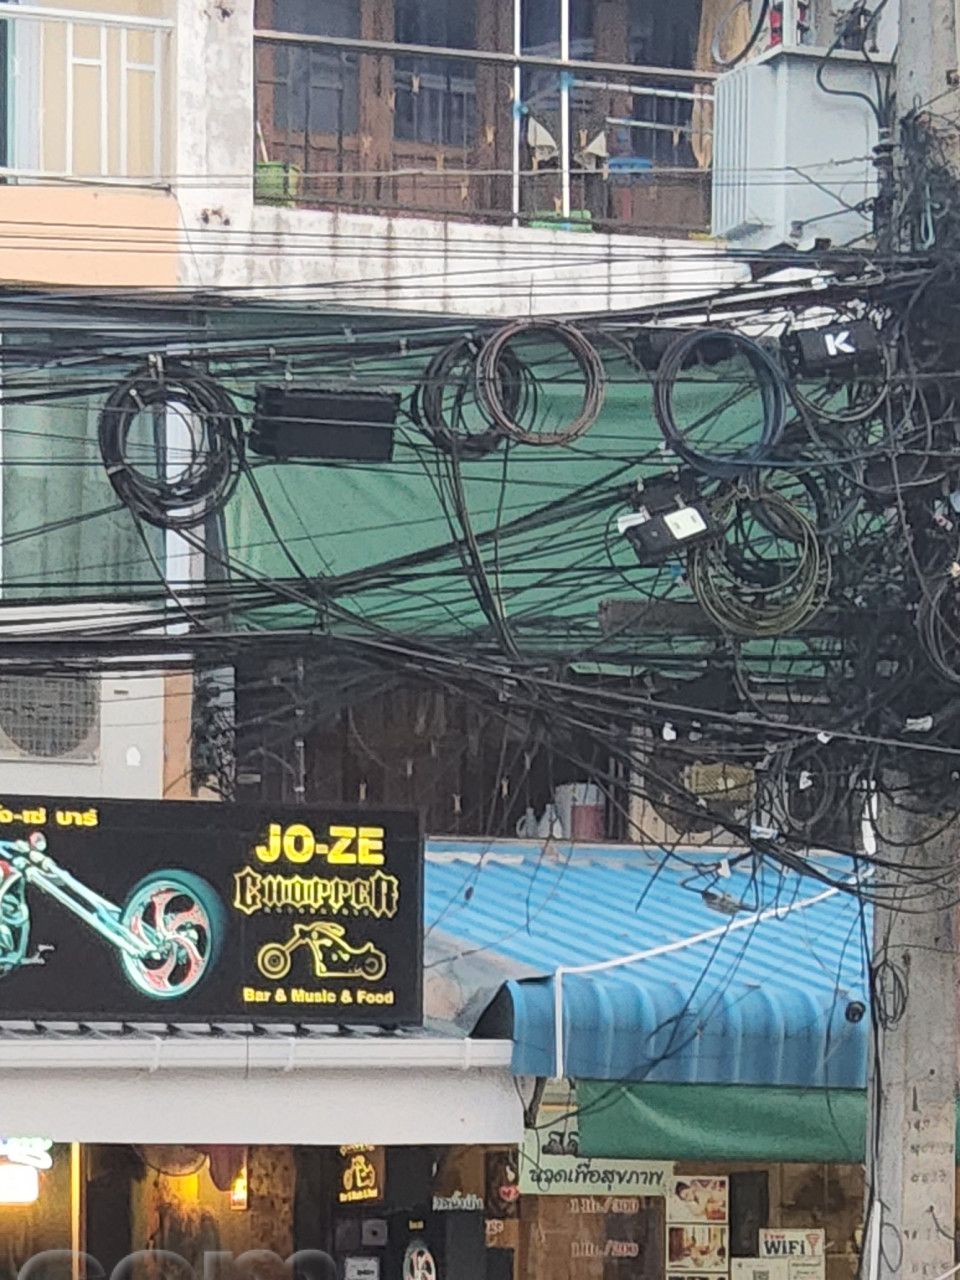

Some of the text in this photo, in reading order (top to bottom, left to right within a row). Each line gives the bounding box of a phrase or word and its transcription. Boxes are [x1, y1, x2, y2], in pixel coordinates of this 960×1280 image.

[255, 823, 385, 865] JO-ZE
[243, 987, 394, 1005] Bar & Music & Food
